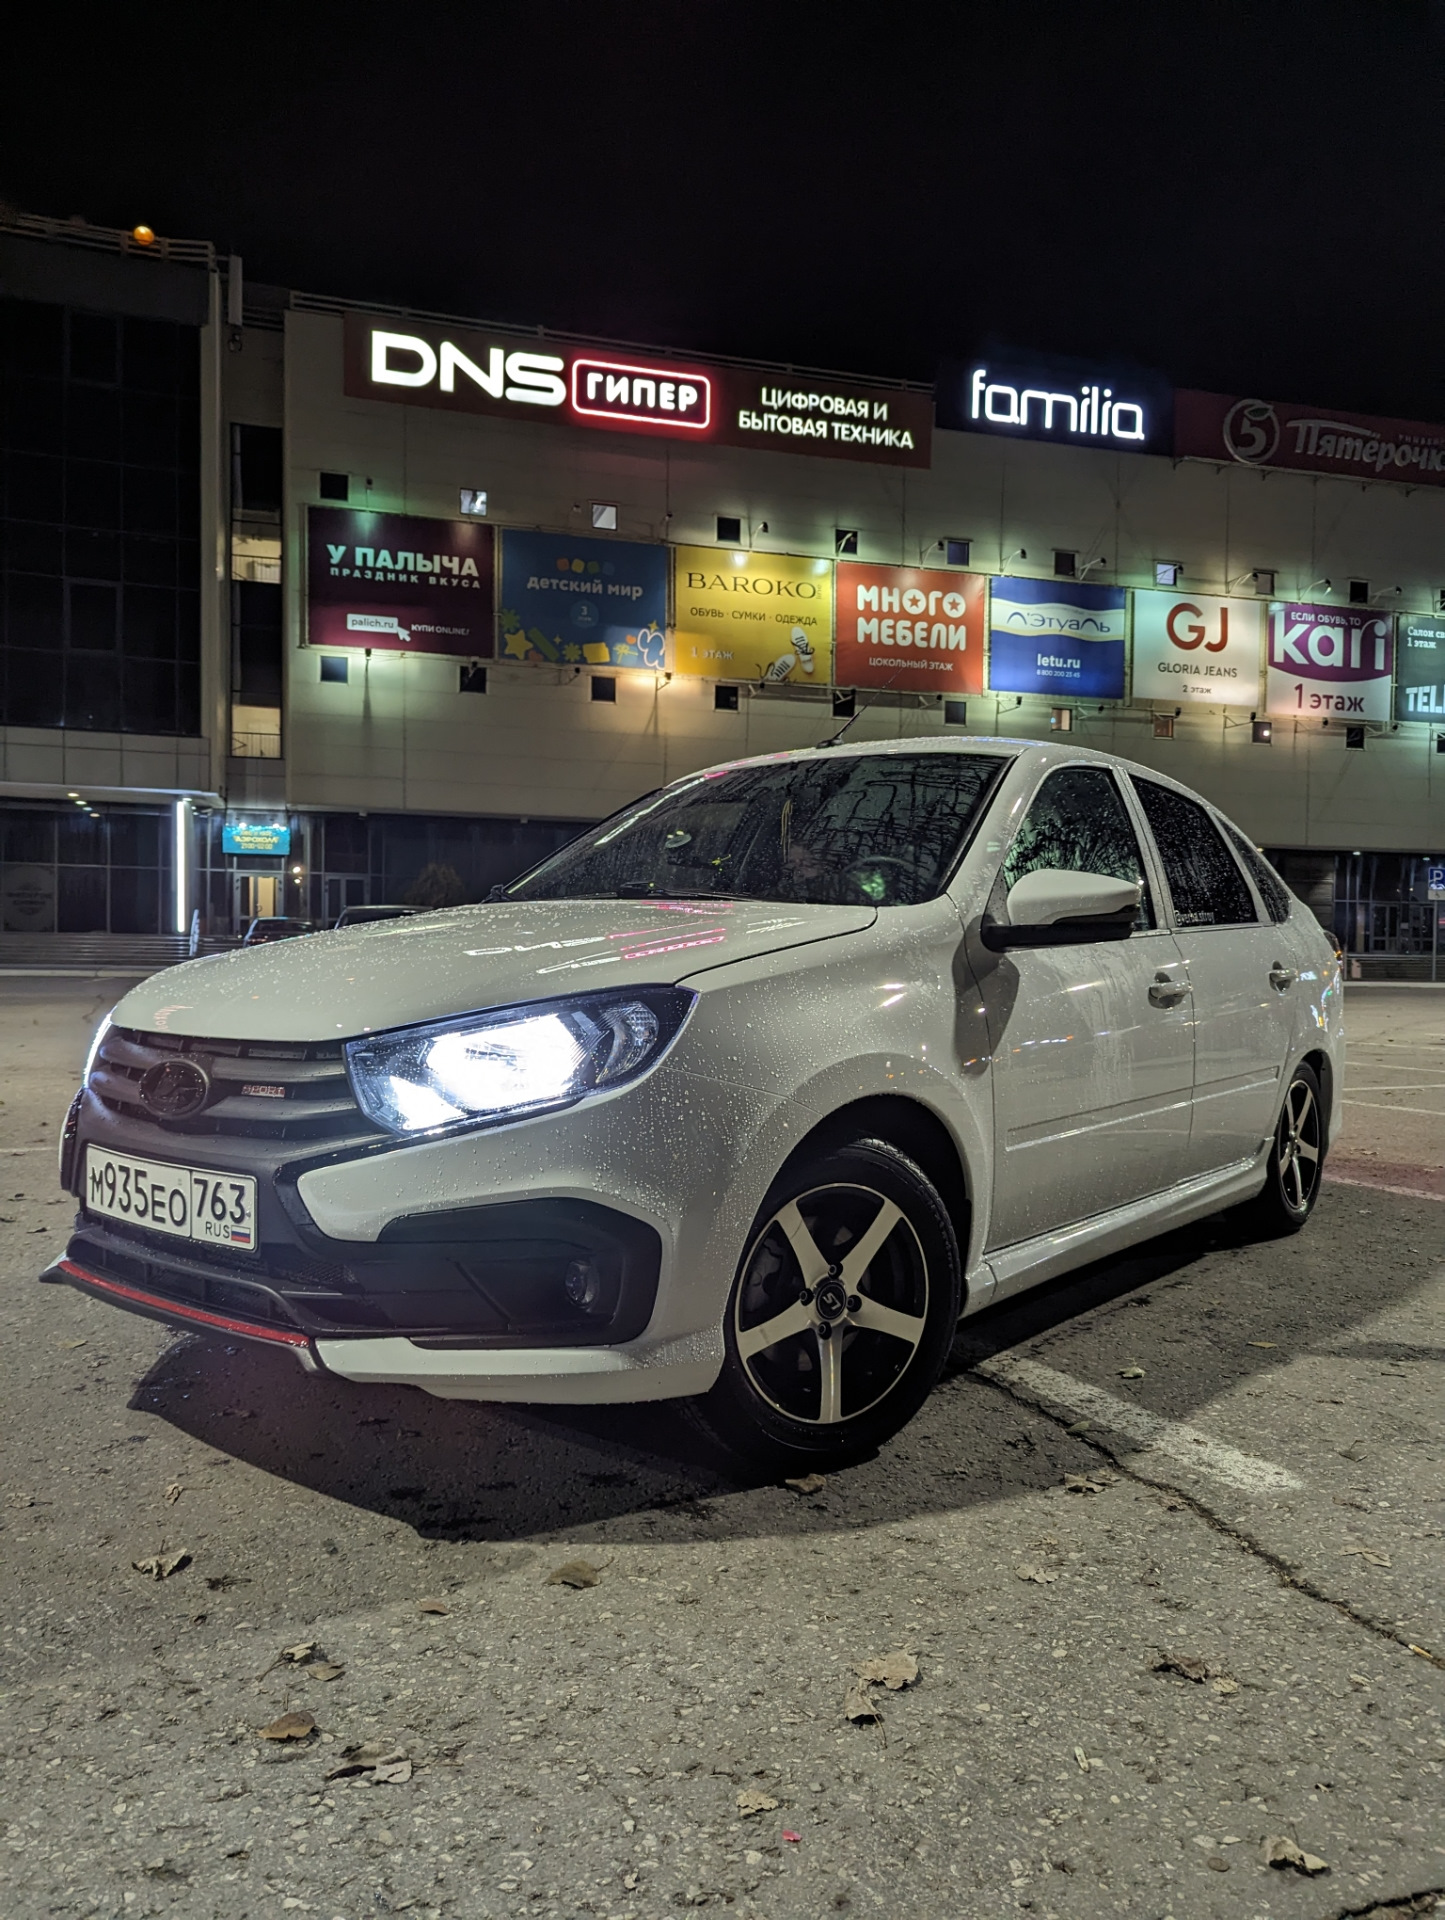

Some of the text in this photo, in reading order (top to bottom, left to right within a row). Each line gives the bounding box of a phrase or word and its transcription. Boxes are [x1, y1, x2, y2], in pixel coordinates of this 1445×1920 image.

[371, 330, 567, 407] DNS
[586, 371, 698, 412] ГИПЕР
[761, 386, 888, 421] ЦИФРОВАЯ И
[971, 369, 1145, 440] familia
[738, 409, 914, 450] БЫТОВАЯ ТЕХНИКА
[1286, 418, 1445, 473] Пятёрочк
[326, 543, 480, 577] У ПАЛЫЧА
[330, 567, 481, 589] ПРАЗДНИК ВКУСА
[526, 576, 643, 601] детский мир
[685, 571, 816, 599] BAROKO
[857, 584, 966, 619] МНОГО
[351, 617, 395, 629] palich.ru
[411, 623, 471, 636] КУПИ ONLINE!
[690, 607, 818, 626] ОБУВЬ СУМКИ ОДЕЖДА
[1166, 602, 1229, 653] GJ
[1291, 611, 1361, 626] ЕСЛИ ОБУВЬ, ТО
[857, 616, 967, 652] МЕБЕЛИ
[1273, 606, 1387, 671] kari
[1407, 625, 1445, 639] Салон св
[1407, 637, 1437, 649] 1 этаж
[691, 646, 698, 658] 1
[868, 657, 954, 671] ЦОКОЛЬНЫЙ ЭТАЖ
[1037, 653, 1081, 669] letu.ru
[1157, 661, 1238, 678] GLORIA JEANS
[1182, 684, 1212, 694] 2 этаж
[1294, 683, 1365, 713] 1 этаж
[1405, 685, 1445, 714] TEL
[193, 1178, 245, 1224] 763
[205, 1221, 230, 1238] RUS
